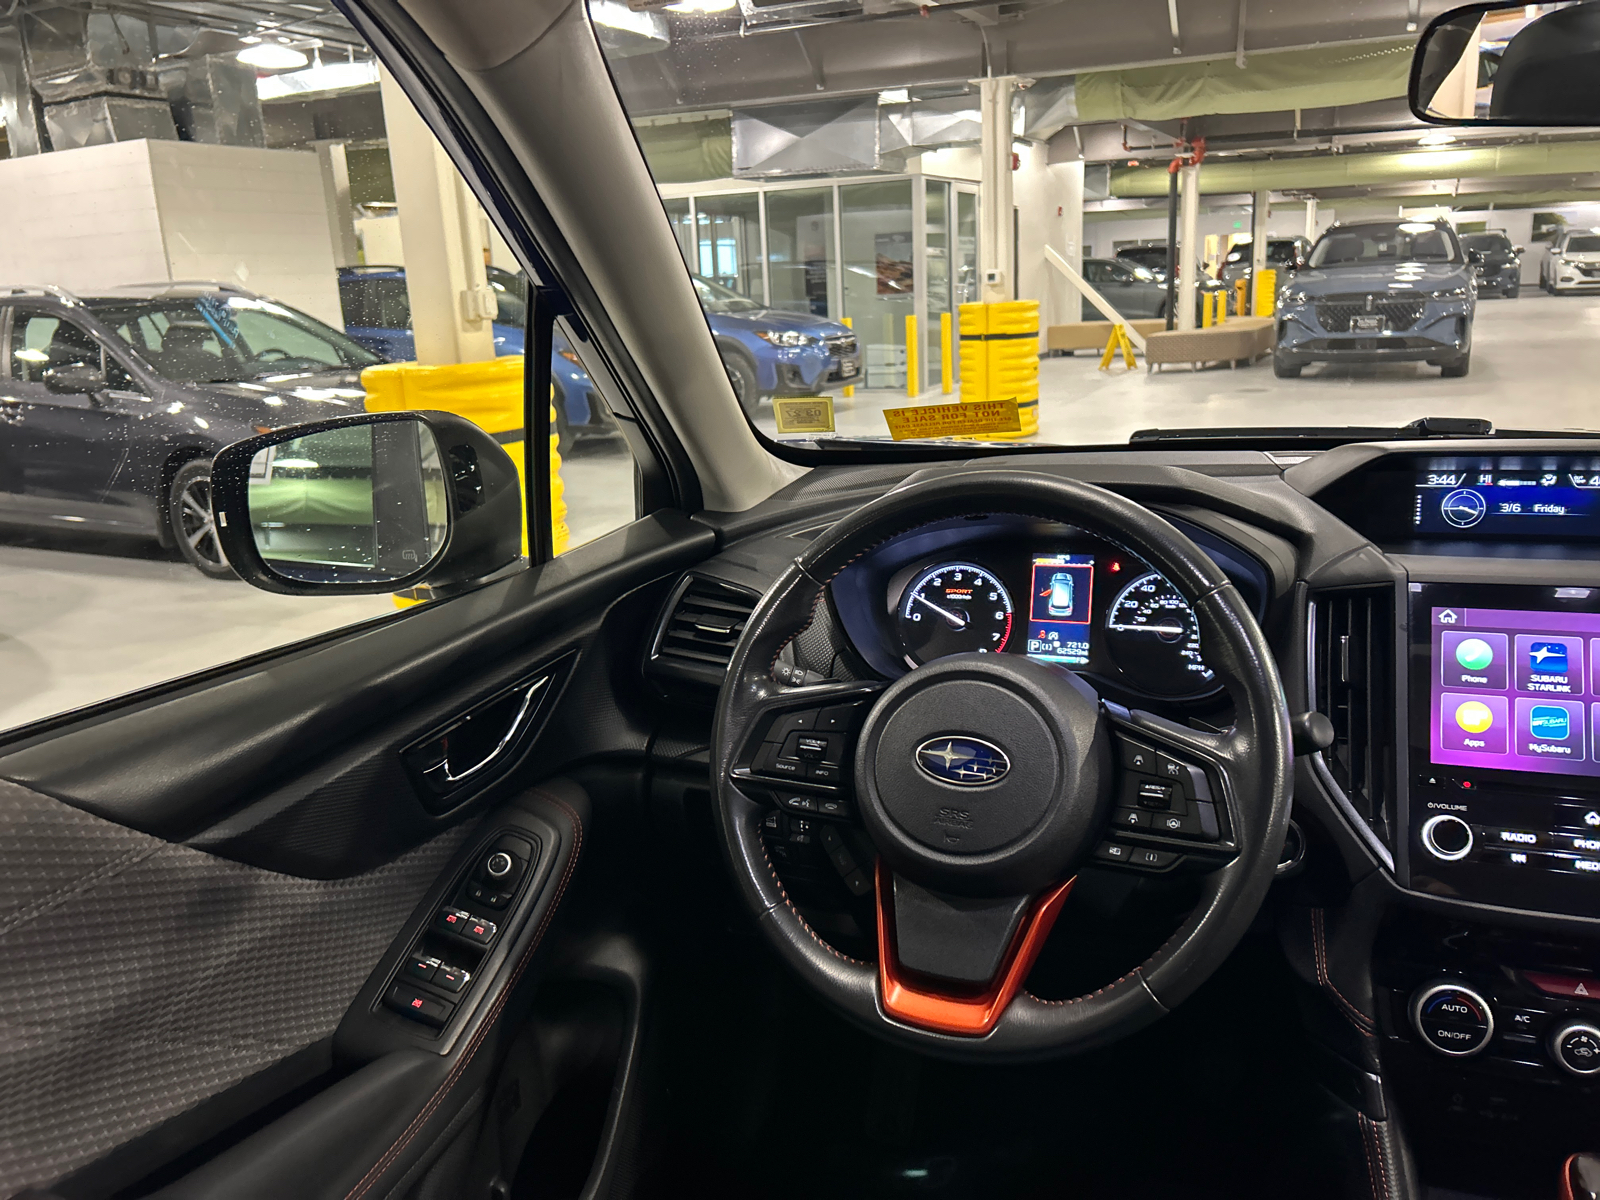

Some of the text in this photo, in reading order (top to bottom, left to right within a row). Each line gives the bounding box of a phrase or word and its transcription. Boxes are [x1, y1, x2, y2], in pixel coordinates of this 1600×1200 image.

[1428, 474, 1456, 485] 3:44
[1480, 474, 1493, 483] HI
[1589, 475, 1600, 486] 4
[1500, 503, 1565, 515] 3/6 Friday
[954, 572, 963, 581] 3
[933, 577, 942, 586] 2
[973, 578, 983, 586] 4
[1140, 584, 1156, 593] 40
[989, 592, 998, 601] 5
[1124, 600, 1139, 609] 20
[912, 613, 921, 622] 0
[995, 611, 1004, 620] 6
[991, 632, 1001, 641] 7
[1030, 641, 1089, 651] P 721.0
[1187, 663, 1205, 671] MPH
[1461, 674, 1488, 684] Phone
[1530, 674, 1569, 684] SUBARU
[1527, 683, 1571, 693] STARLINK
[1463, 738, 1485, 748] Apps
[1528, 743, 1571, 754] MySubaru
[776, 763, 796, 771] Source
[940, 808, 970, 820] SRS
[1501, 831, 1537, 844] RADIO
[1441, 1003, 1468, 1014] AUTO
[1514, 1014, 1531, 1023] A/C
[1437, 1029, 1472, 1041] ON/OFF
